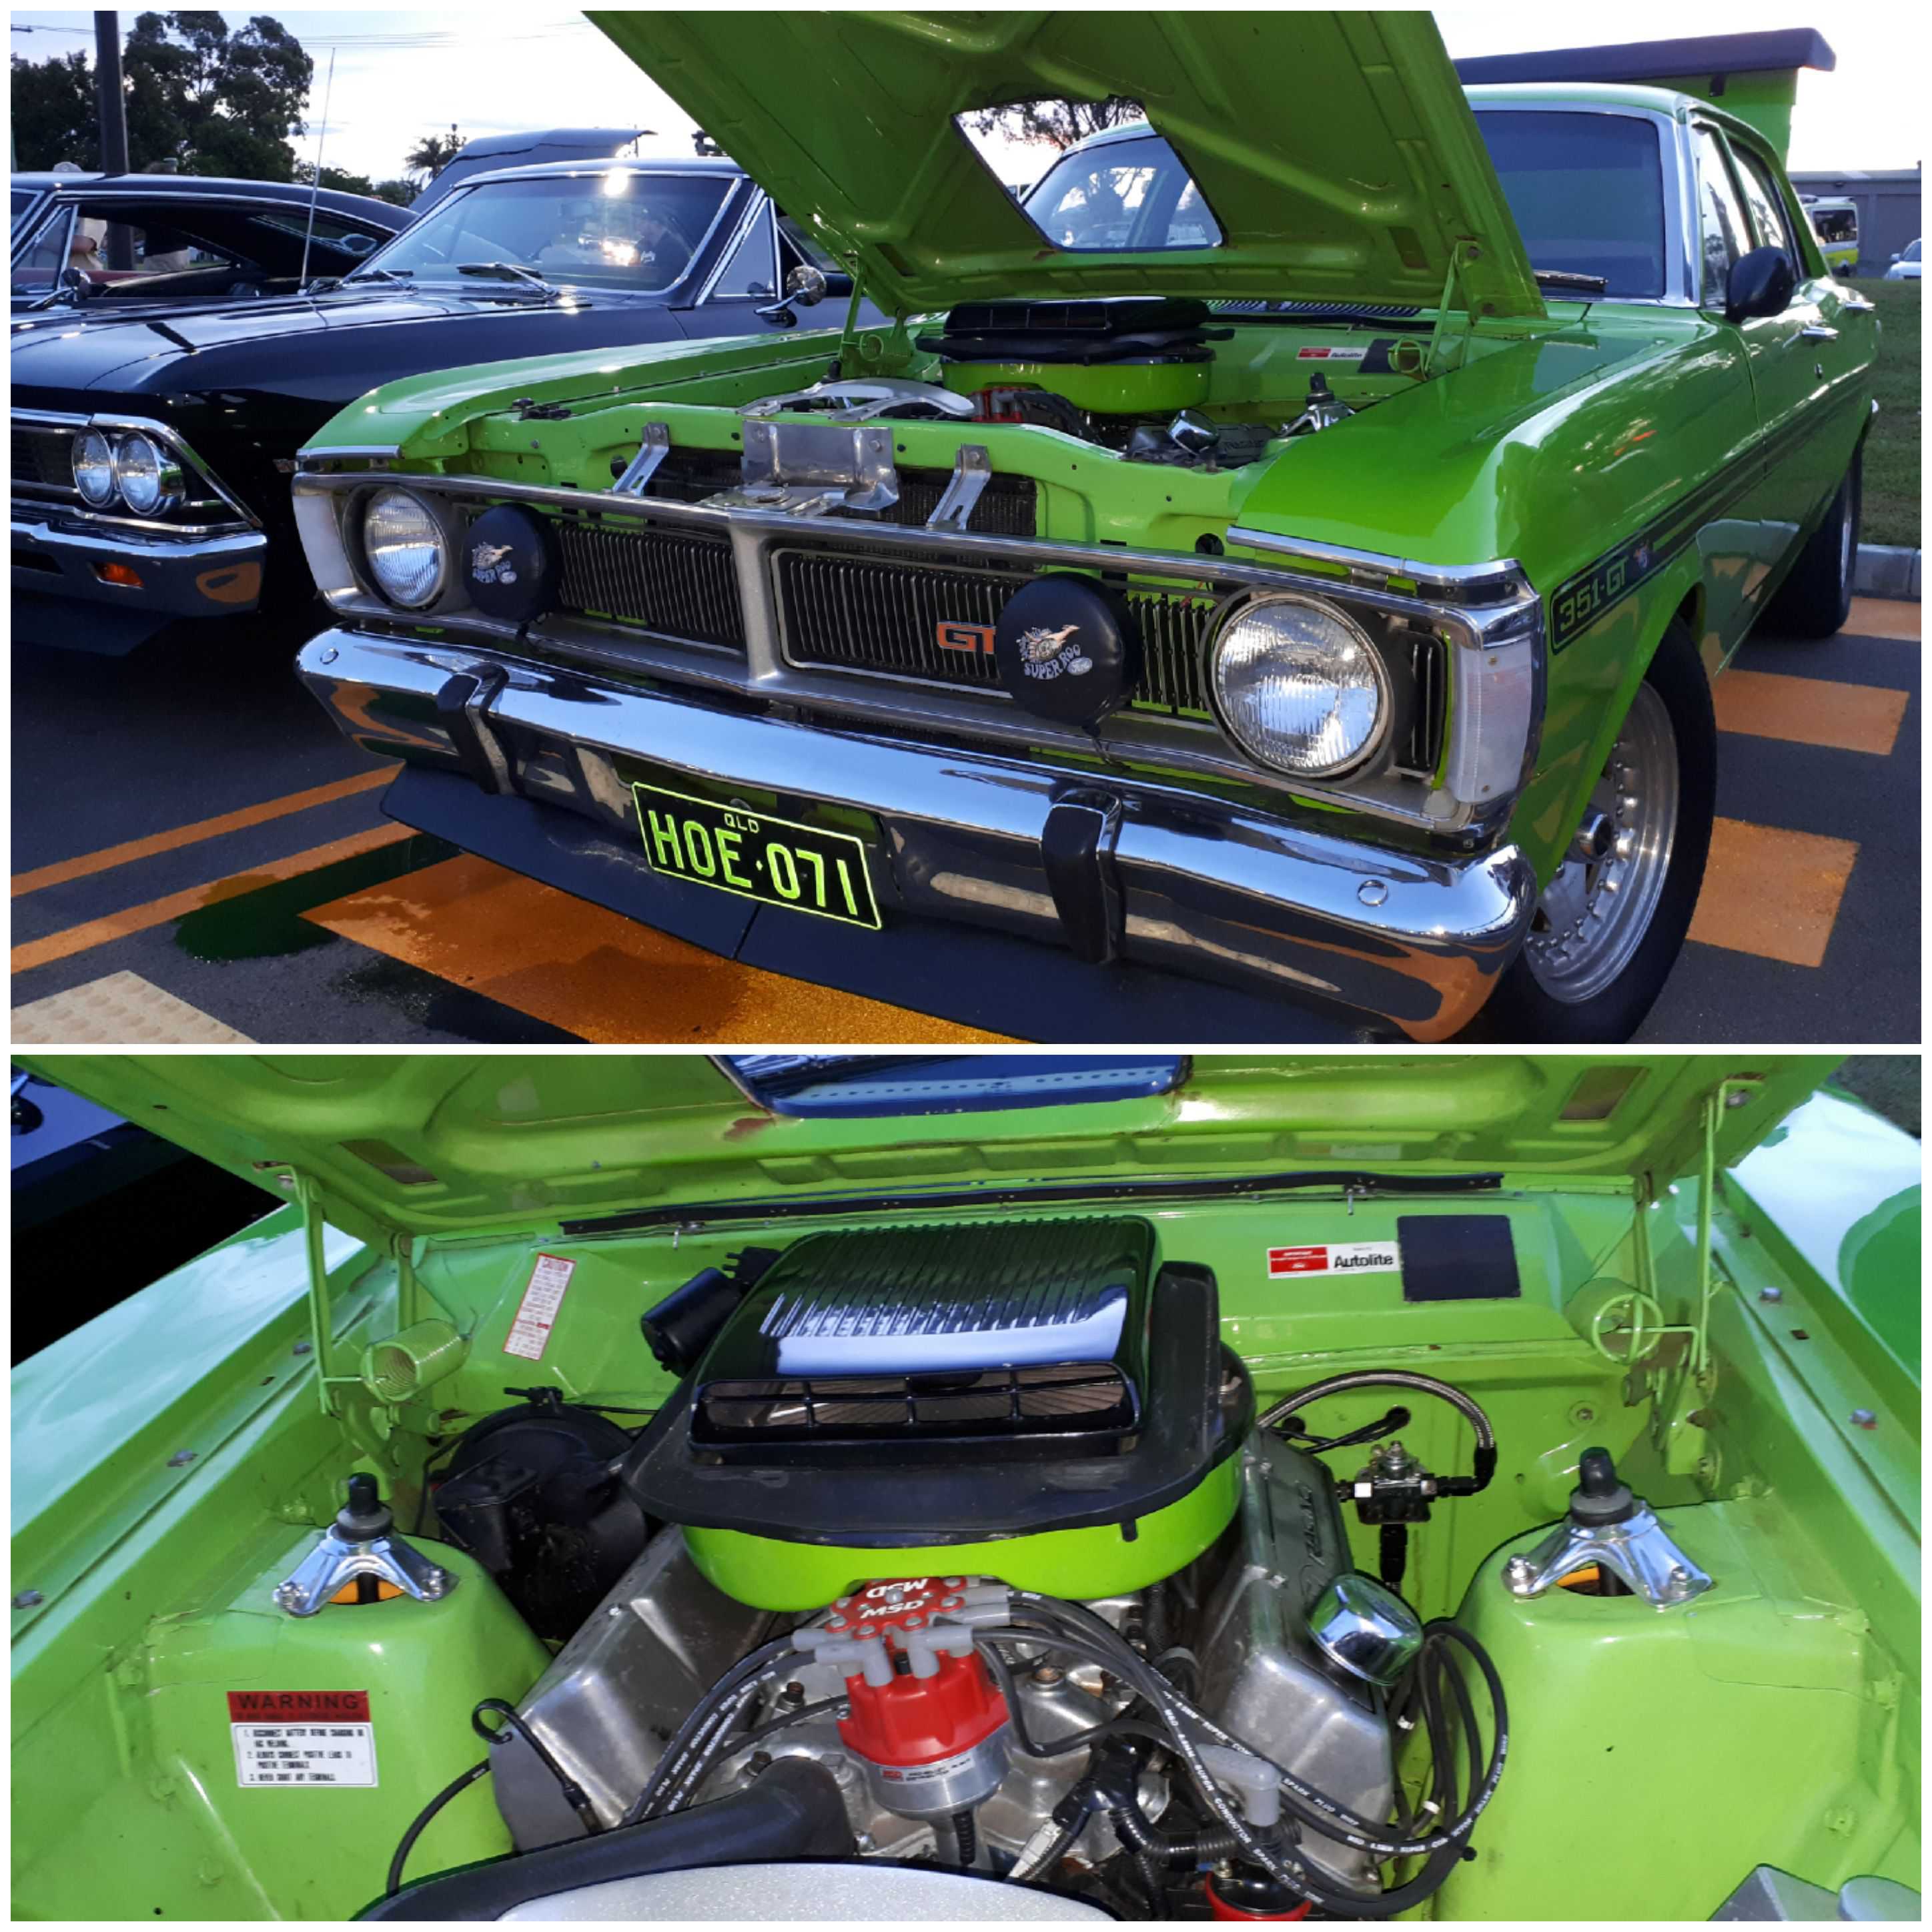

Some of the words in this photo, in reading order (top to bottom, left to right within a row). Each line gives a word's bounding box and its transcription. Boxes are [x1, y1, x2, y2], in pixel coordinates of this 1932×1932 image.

[937, 621, 996, 655] GT
[1024, 658, 1063, 680] SUPER
[1059, 644, 1081, 670] ROO
[724, 812, 760, 834] QLD
[1334, 1253, 1394, 1268] Autolite
[859, 1600, 925, 1619] MSD
[237, 1694, 359, 1710] WARNING
[1283, 1778, 1311, 1796] SPARK
[1195, 1764, 1214, 1791] SUPER
[1215, 1798, 1252, 1843] CONDUCTOR
[1253, 1849, 1278, 1871] SPARK
